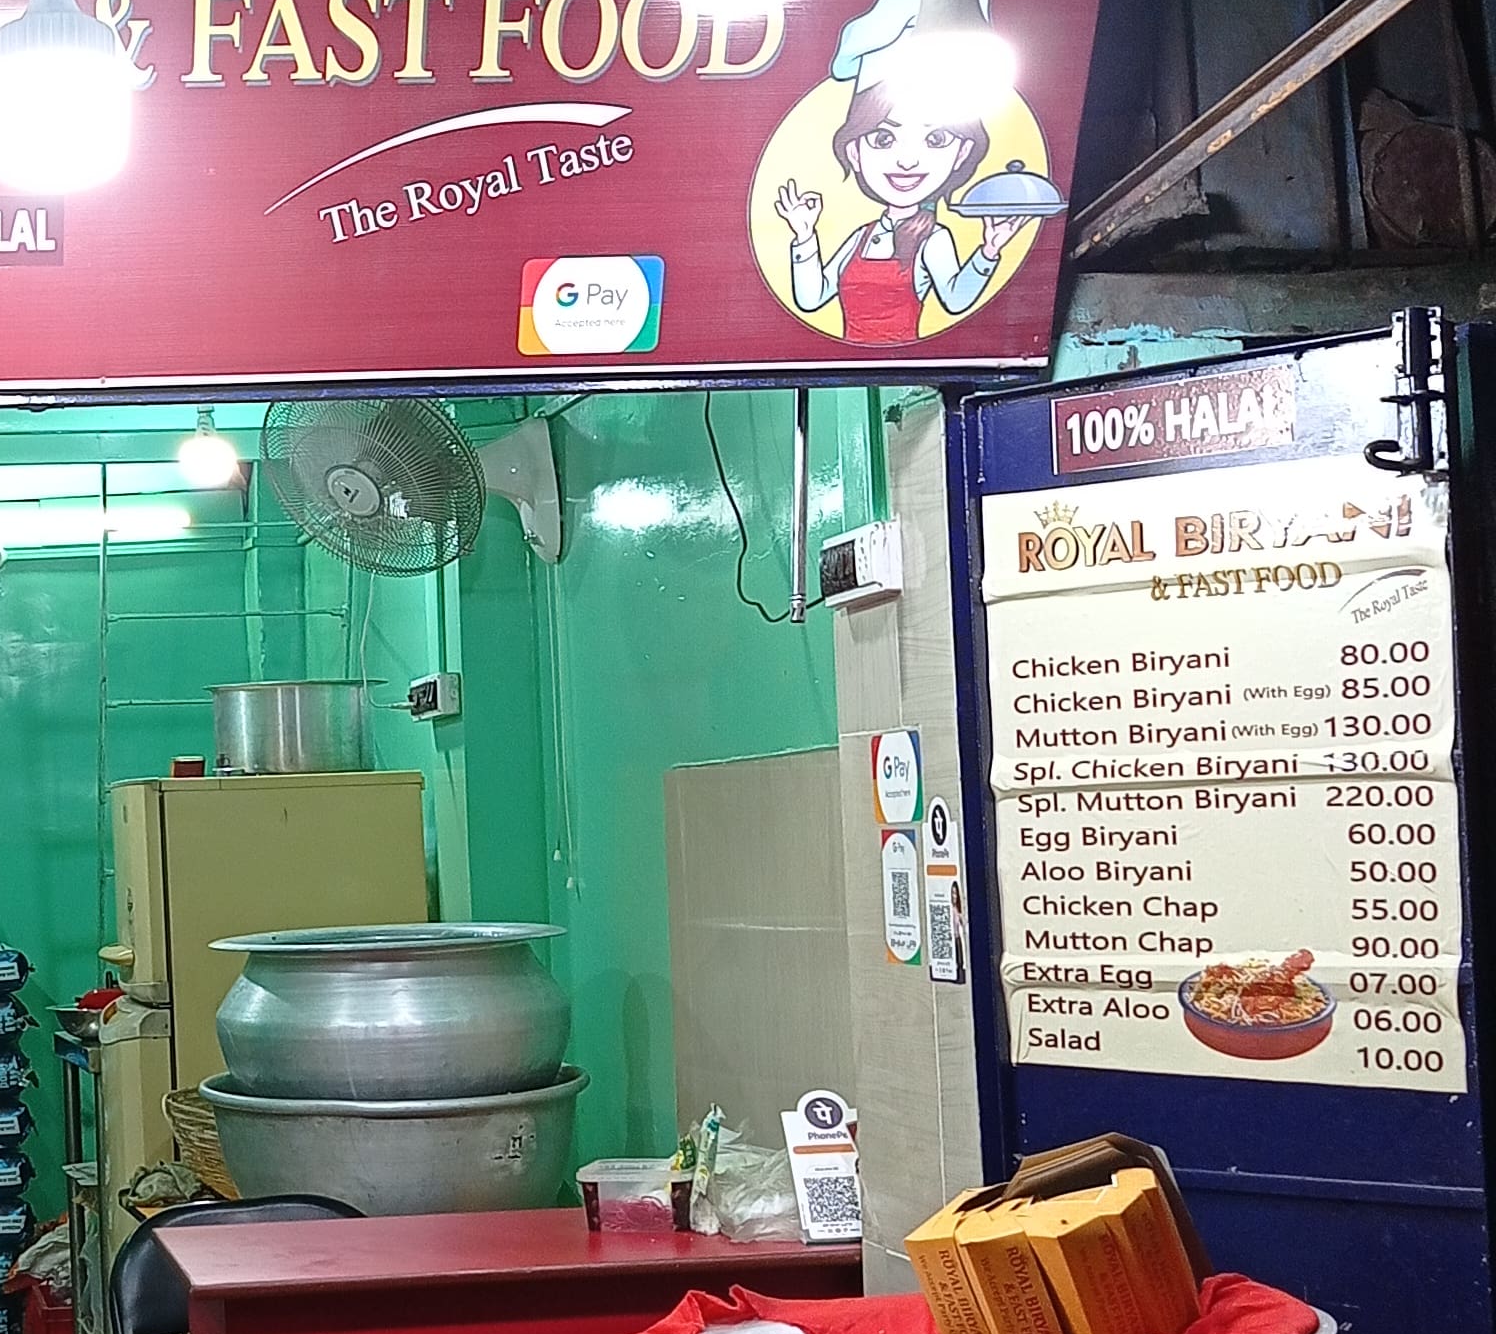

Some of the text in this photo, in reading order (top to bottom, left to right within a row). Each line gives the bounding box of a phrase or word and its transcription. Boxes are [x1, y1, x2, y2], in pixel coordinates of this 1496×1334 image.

[319, 129, 634, 246] The Royal Taste
[1065, 410, 1156, 457] 100%
[1017, 519, 1156, 574] ROYAL
[1150, 561, 1344, 601] & FAST FOOD
[1011, 640, 1430, 682] Chicken Biryani 80.00
[1013, 674, 1432, 716] Chicken Biryani (With Egg) 85.00
[1015, 713, 1433, 751] Mutton Biryani (With Egg) 130.00
[1012, 749, 1430, 784] Spl. Chicken Biryani 130.00
[1017, 784, 1435, 818] Spl. Mutton Biryani 220.00
[1019, 823, 1437, 852] Egg Biryani 60.00
[1020, 860, 1438, 887] Aloo Biryani 50.00
[1022, 895, 1439, 923] Chicken Chap 55.00
[1024, 929, 1440, 959] Mutton Chap 90.00
[1022, 962, 1438, 996] Extra Egg 07.00
[1027, 993, 1443, 1034] Extra Aloo 06.00
[1027, 1027, 1445, 1073] Salad 10.00
